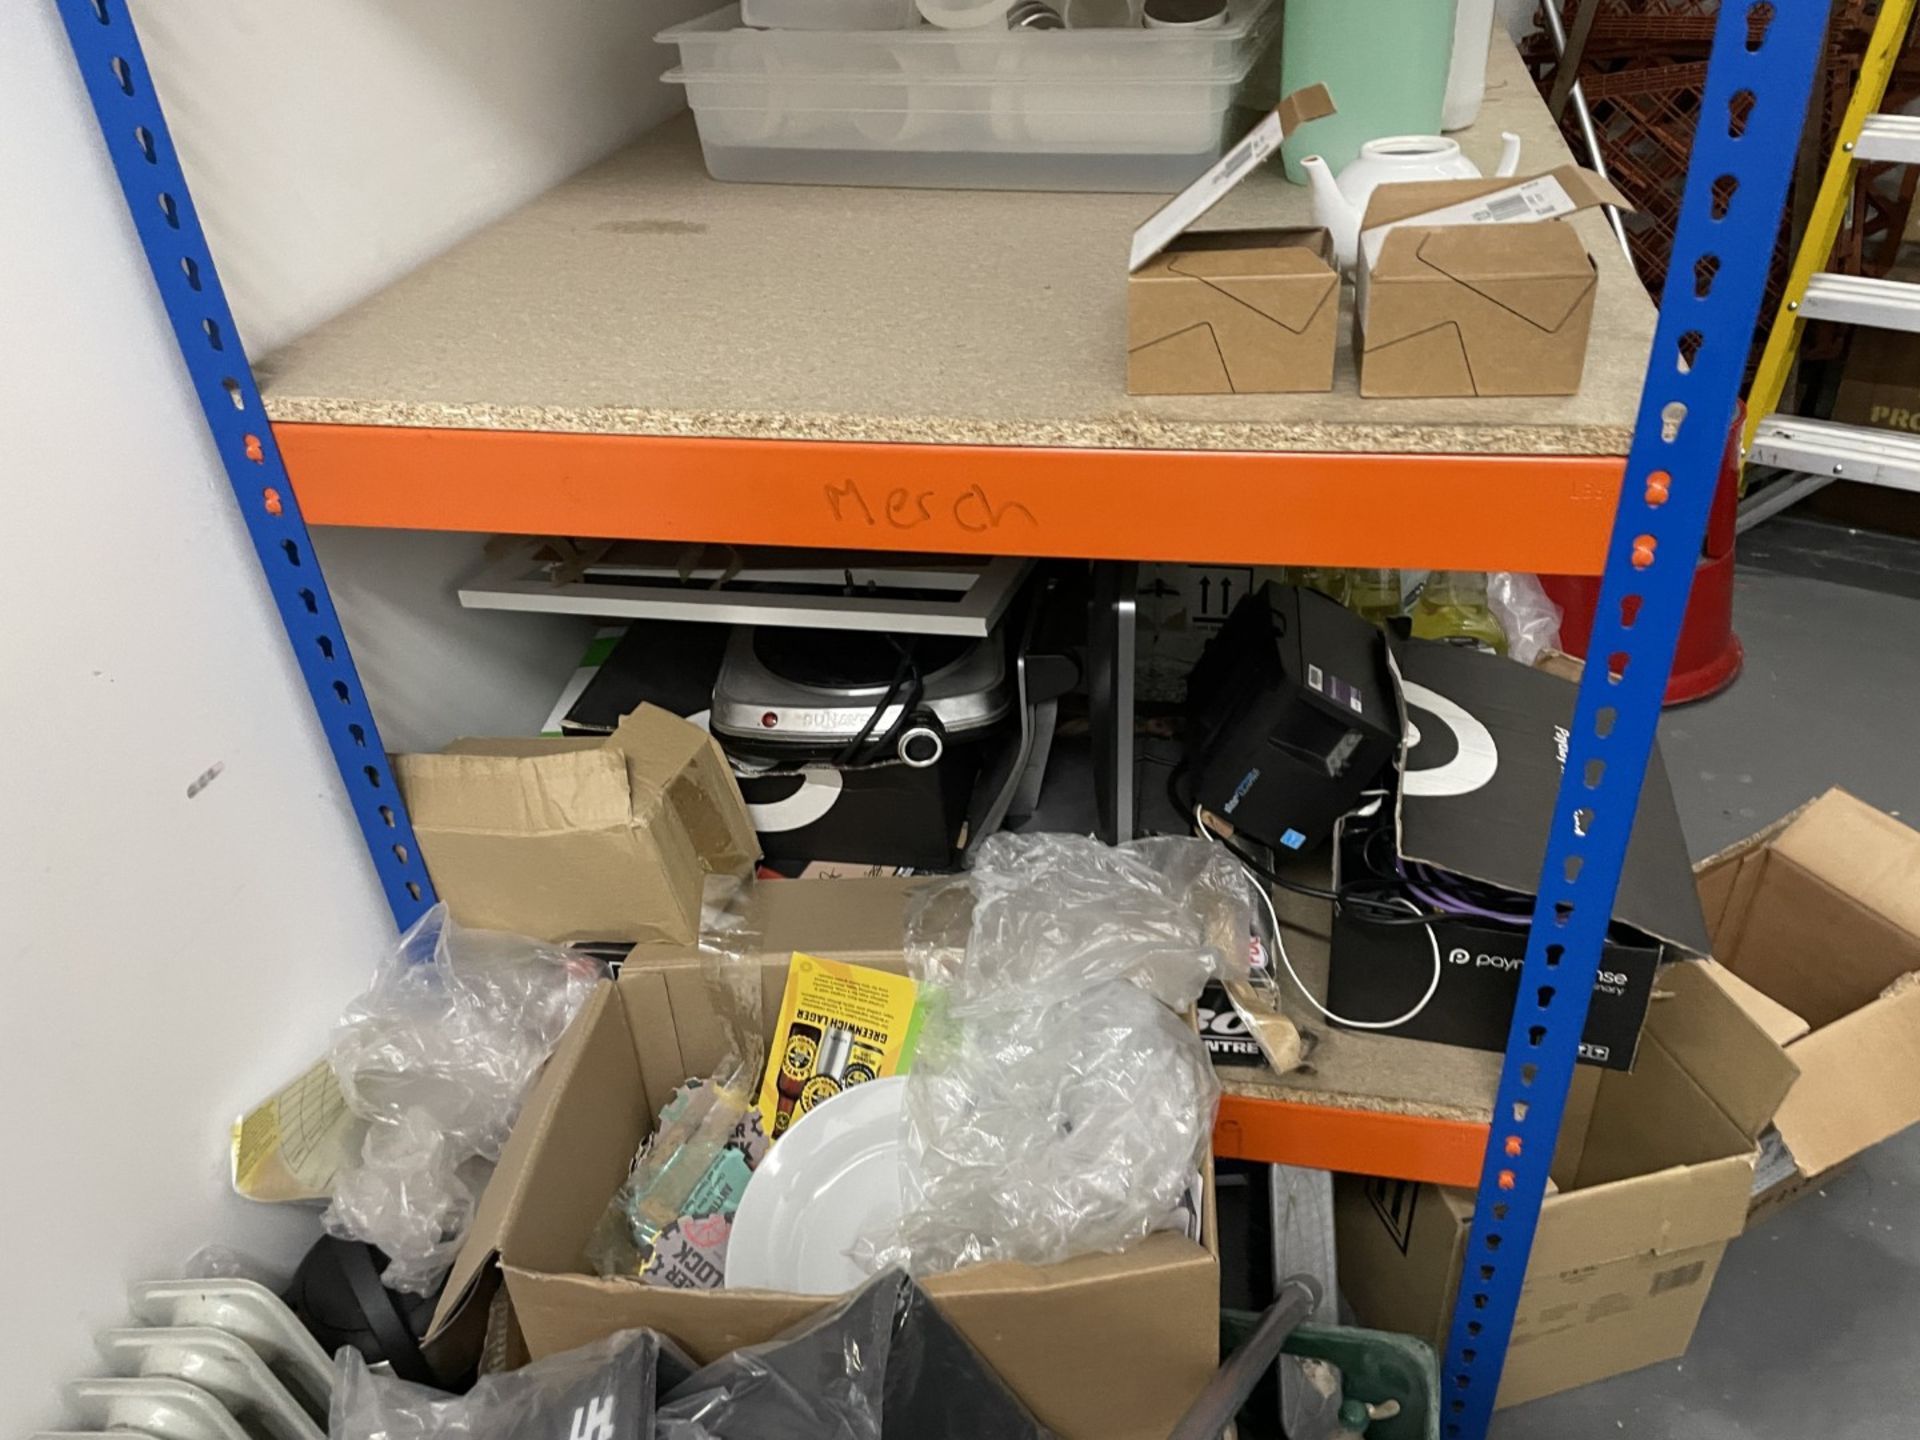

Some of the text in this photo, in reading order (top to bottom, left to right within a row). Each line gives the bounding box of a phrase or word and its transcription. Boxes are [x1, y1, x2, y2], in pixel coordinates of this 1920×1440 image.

[823, 478, 1039, 533] Merch
[796, 1009, 829, 1027] LAGER
[829, 1017, 889, 1044] GREENWICH
[1204, 1039, 1260, 1055] NTRE
